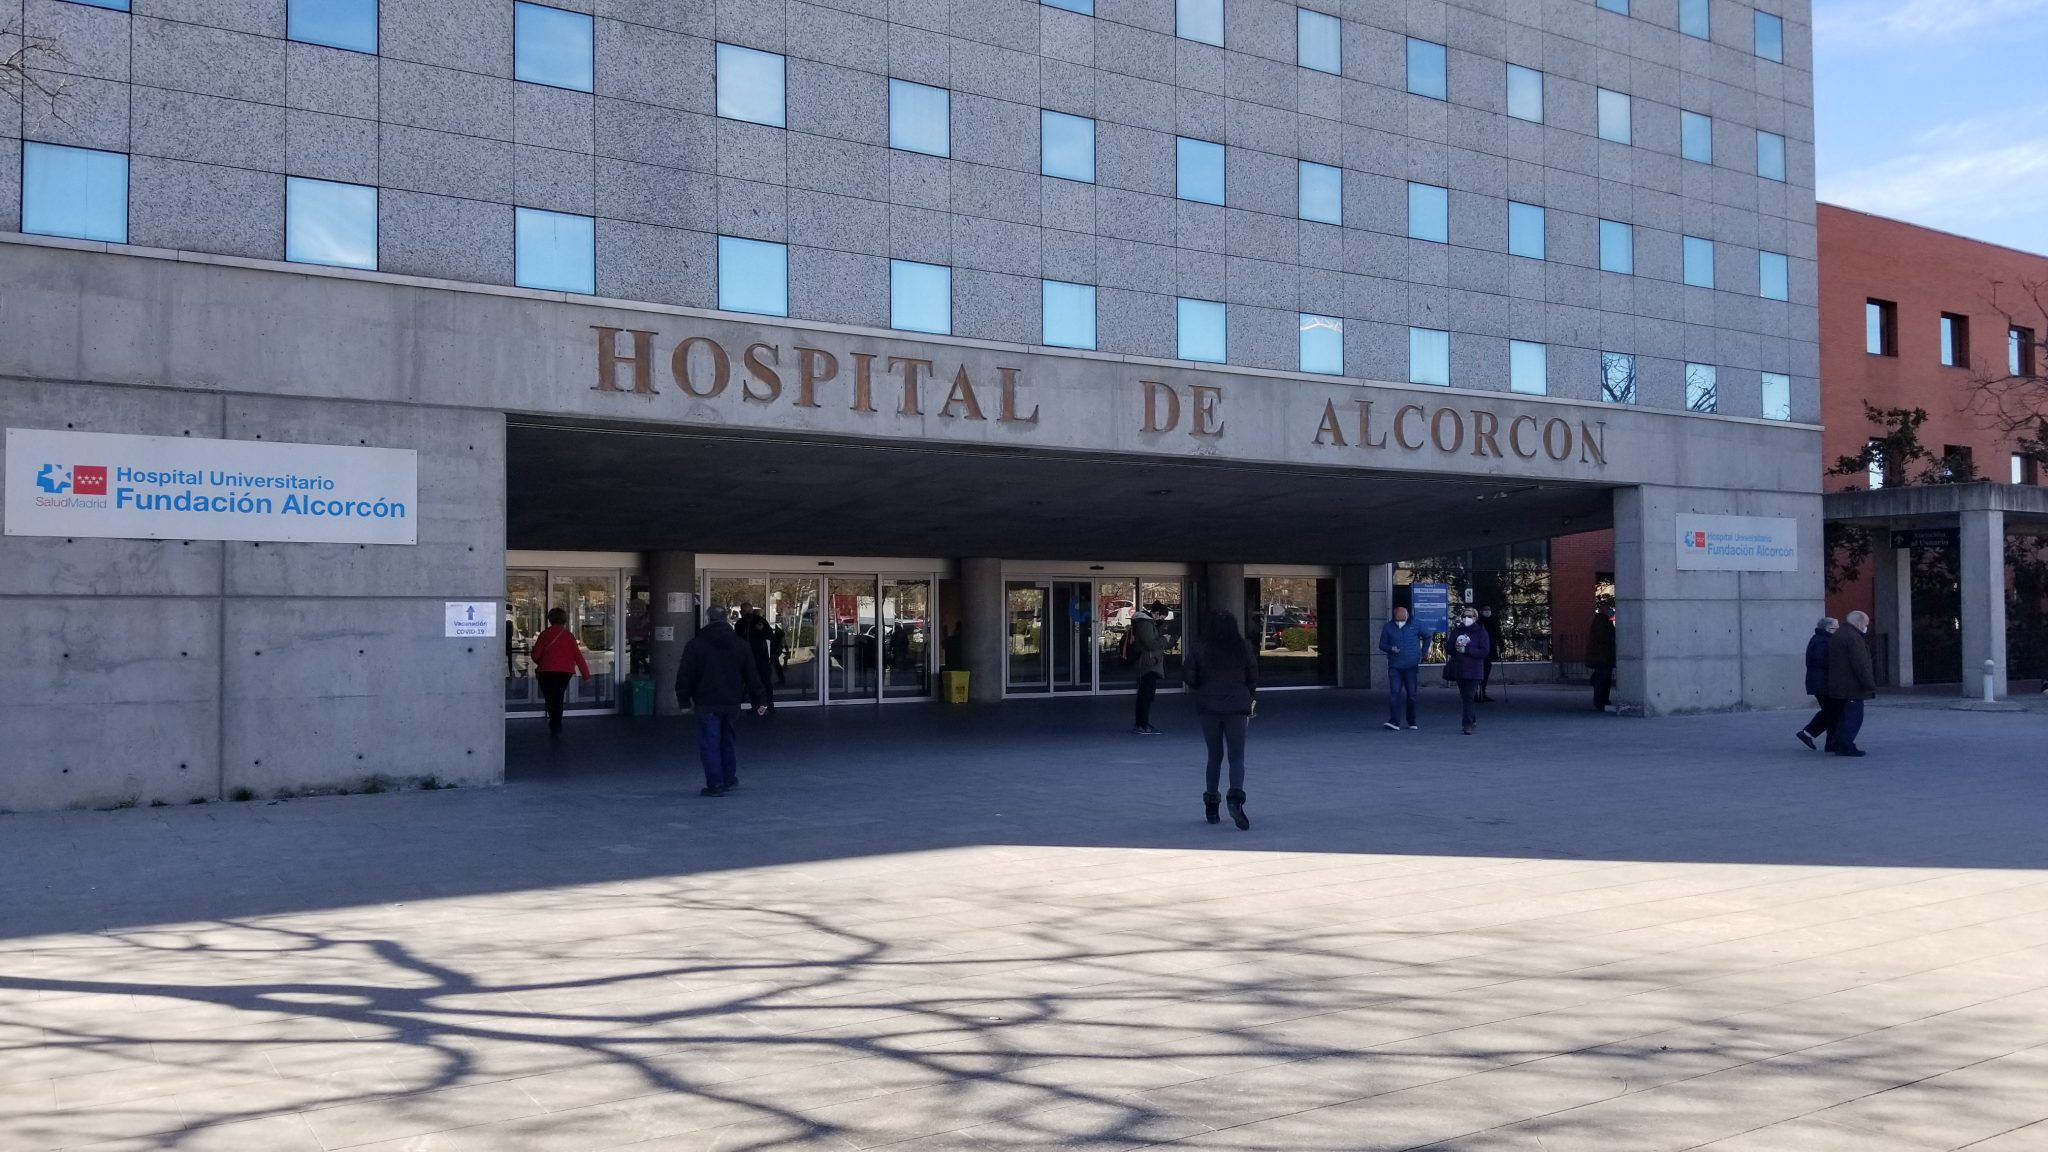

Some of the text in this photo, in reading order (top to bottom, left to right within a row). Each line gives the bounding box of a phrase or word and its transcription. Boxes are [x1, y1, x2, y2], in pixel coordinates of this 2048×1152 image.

[589, 325, 1608, 466] HOSPITAL DE ALCORCON
[116, 466, 335, 491] Hospital Universitario
[35, 496, 107, 510] SaludMadrid
[116, 487, 406, 518] Fundación Alcorcón
[1708, 532, 1733, 543] Hospital
[1708, 543, 1754, 556] Fundación
[1756, 545, 1794, 557] Alcorcón
